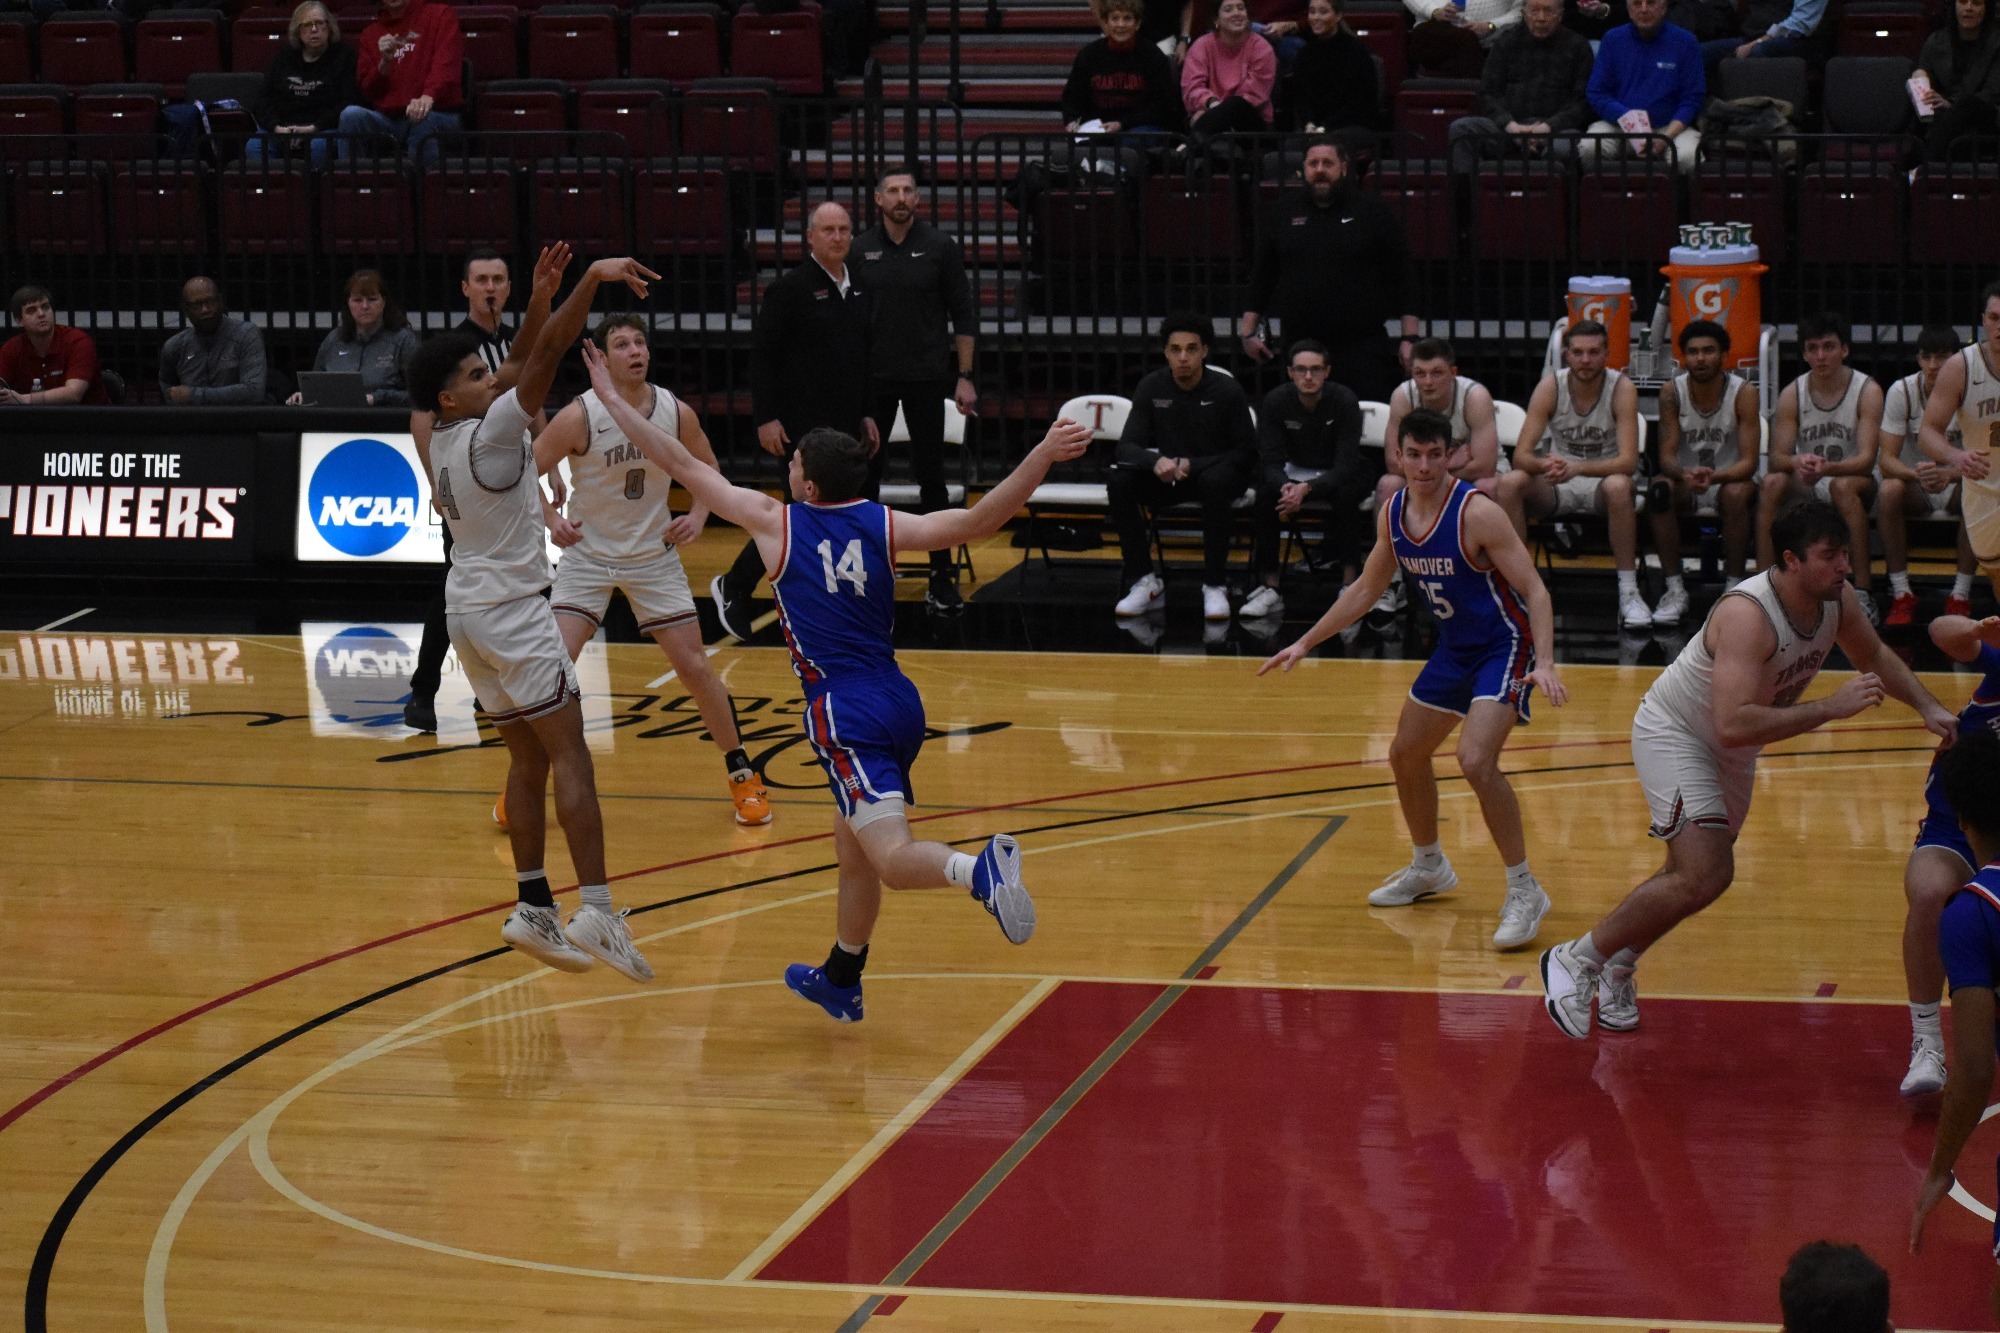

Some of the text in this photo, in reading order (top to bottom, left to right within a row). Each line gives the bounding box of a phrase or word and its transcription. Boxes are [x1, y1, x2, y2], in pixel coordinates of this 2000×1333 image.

[1583, 302, 1605, 324] G
[1694, 284, 1722, 314] G
[1086, 401, 1114, 431] T
[44, 453, 181, 478] HOME OF THE
[624, 468, 645, 500] 0
[318, 496, 417, 527] NCAA
[817, 539, 868, 597] 14
